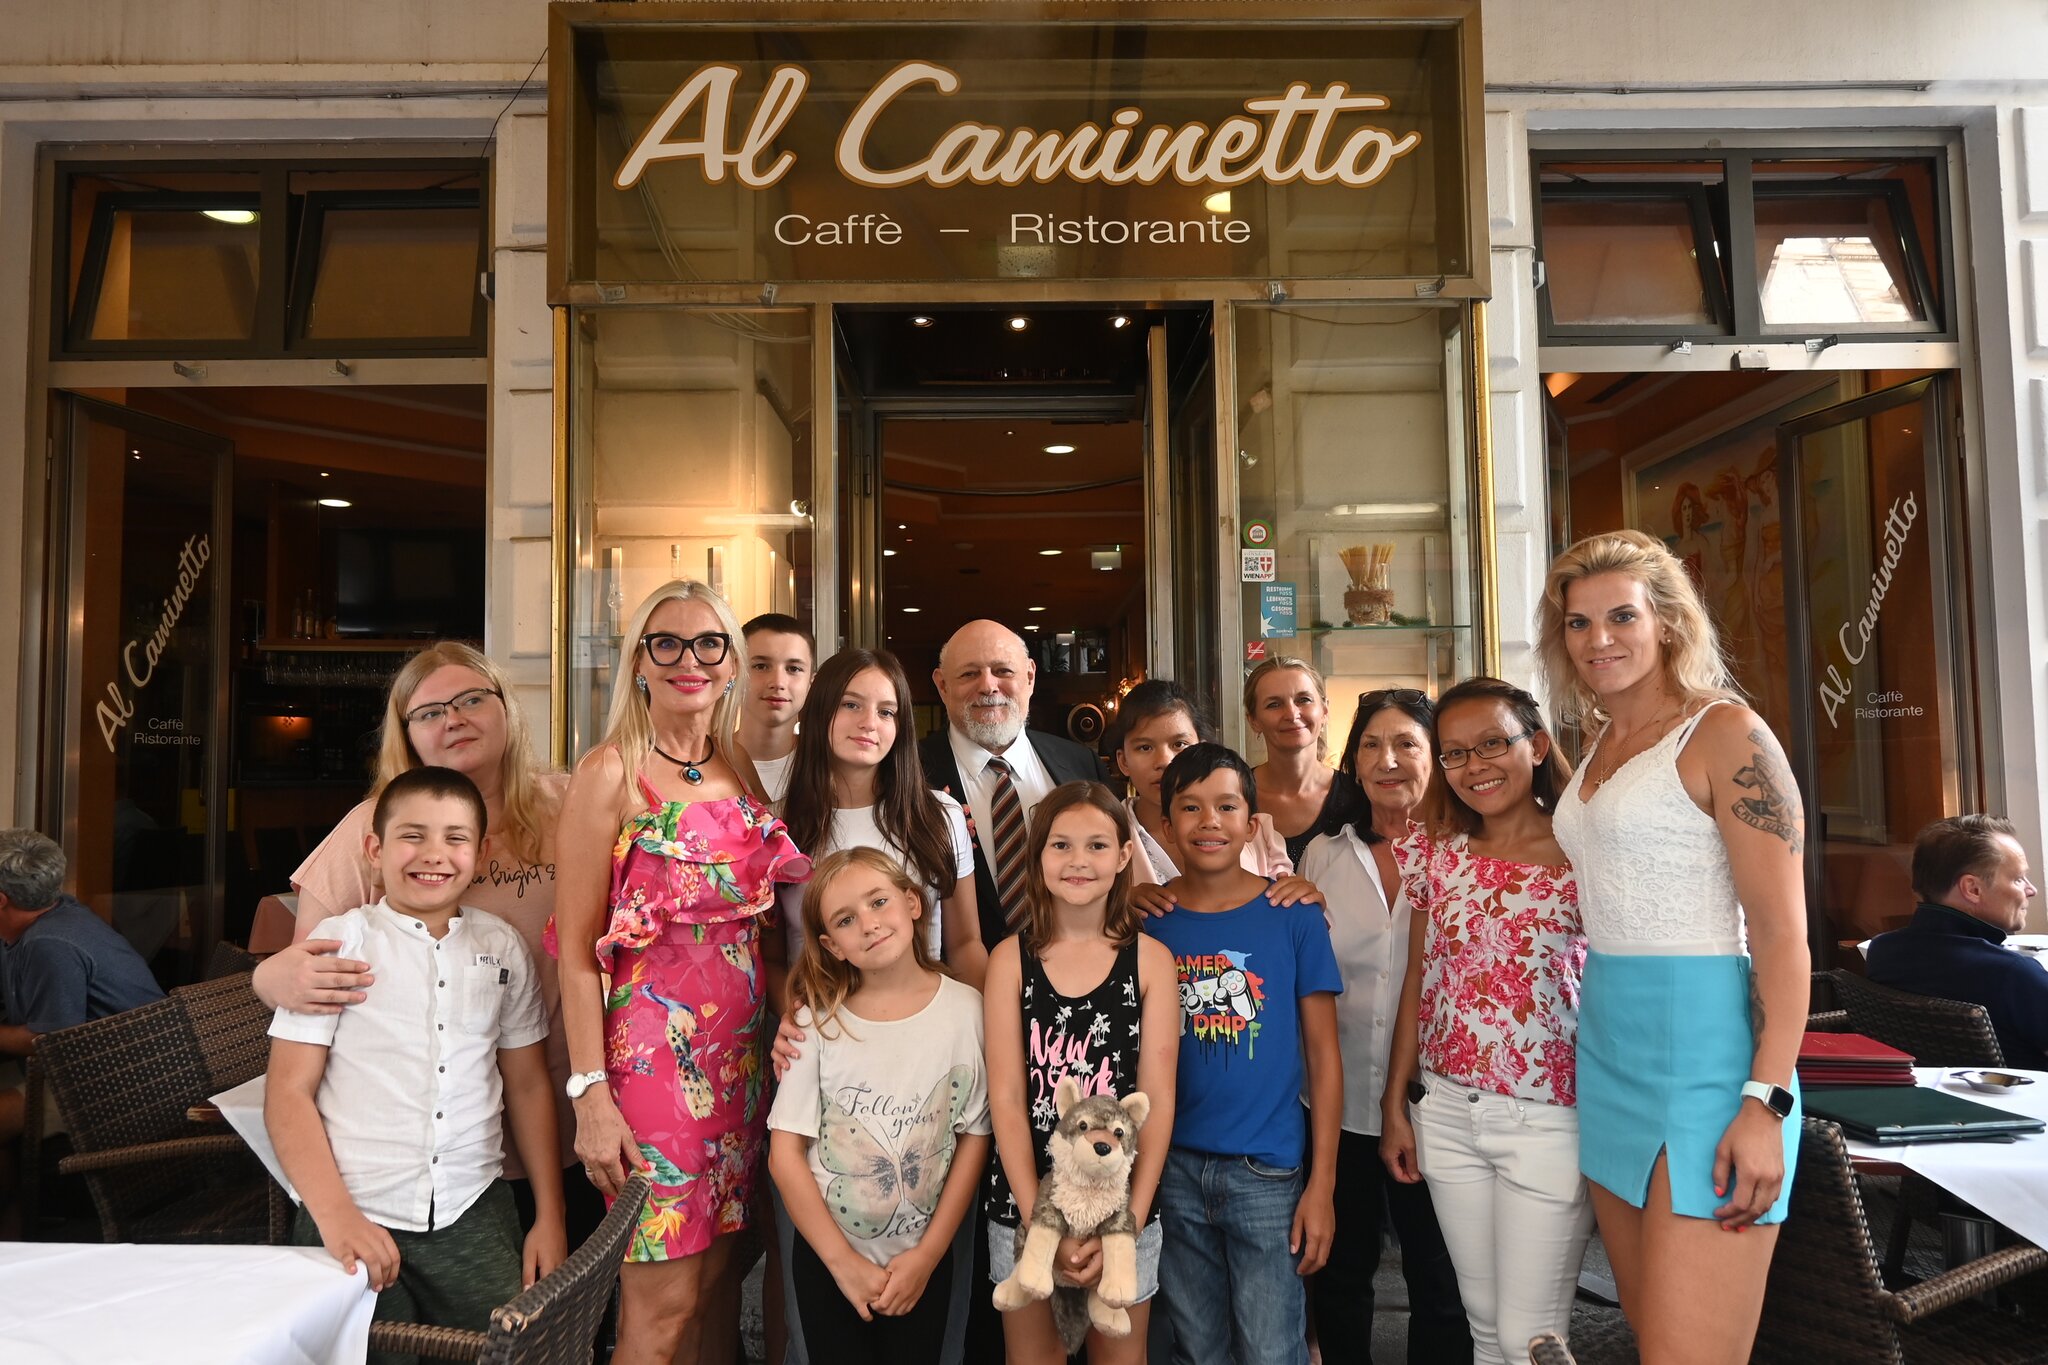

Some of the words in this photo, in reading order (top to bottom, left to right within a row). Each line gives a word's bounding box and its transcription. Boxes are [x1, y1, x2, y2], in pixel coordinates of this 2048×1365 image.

[613, 63, 809, 190] Al
[835, 59, 1421, 190] Caminetto
[774, 214, 903, 246] Caffè
[1009, 213, 1251, 246] Ristorante
[1818, 664, 1852, 728] Al
[1839, 490, 1918, 666] Caminetto
[96, 681, 134, 753] Al
[124, 533, 211, 688] Caminetto
[1855, 705, 1923, 718] Ristorante
[1866, 691, 1903, 703] Caffè
[148, 718, 184, 730] Caffè
[134, 733, 200, 745] Ristorante
[489, 860, 542, 898] bright
[1175, 954, 1234, 976] AMER
[1193, 1014, 1246, 1042] DRIP
[1030, 1021, 1093, 1066] New
[835, 1086, 919, 1117] Follow
[890, 1112, 937, 1138] your
